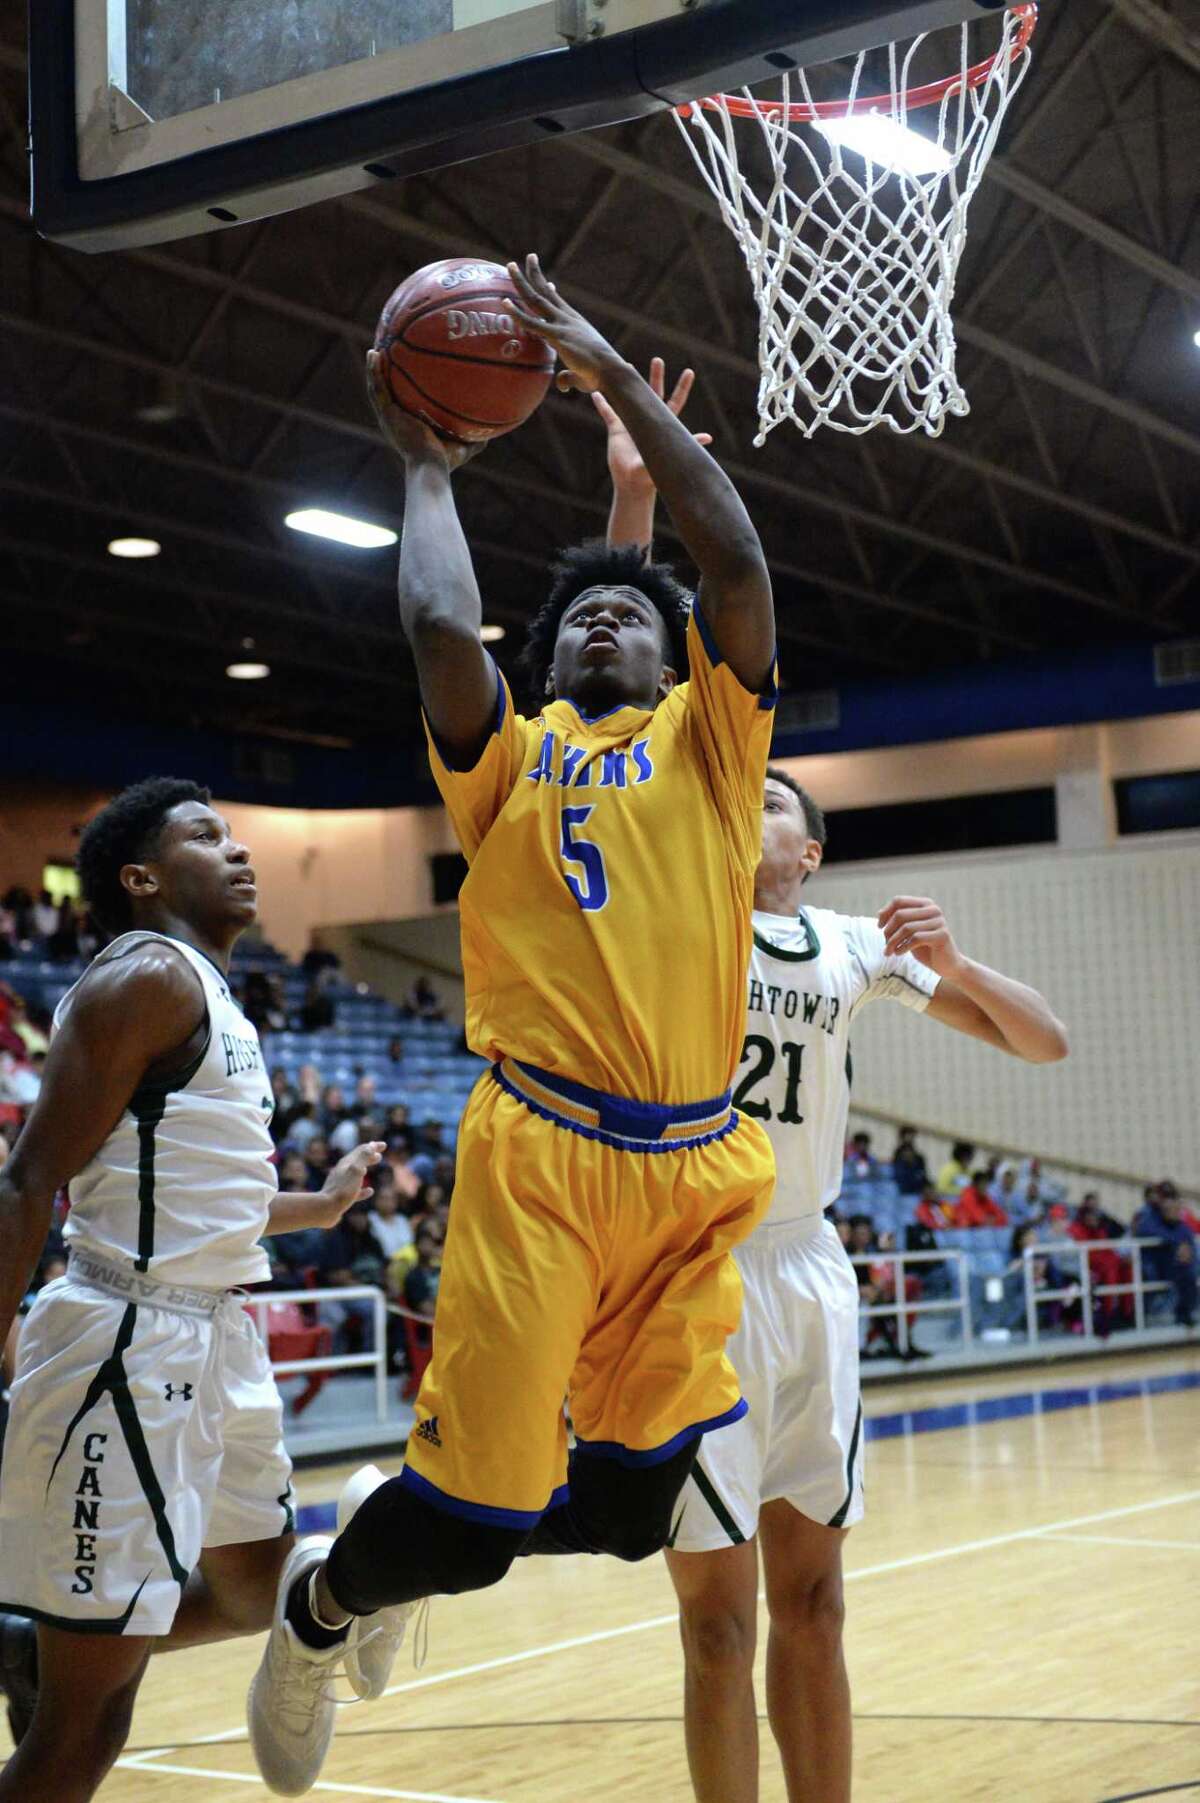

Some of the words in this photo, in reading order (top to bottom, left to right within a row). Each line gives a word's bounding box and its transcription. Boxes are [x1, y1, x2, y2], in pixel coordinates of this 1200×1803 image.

[560, 803, 609, 912] 5
[731, 1034, 806, 1125] 21
[71, 1433, 108, 1594] CANES
